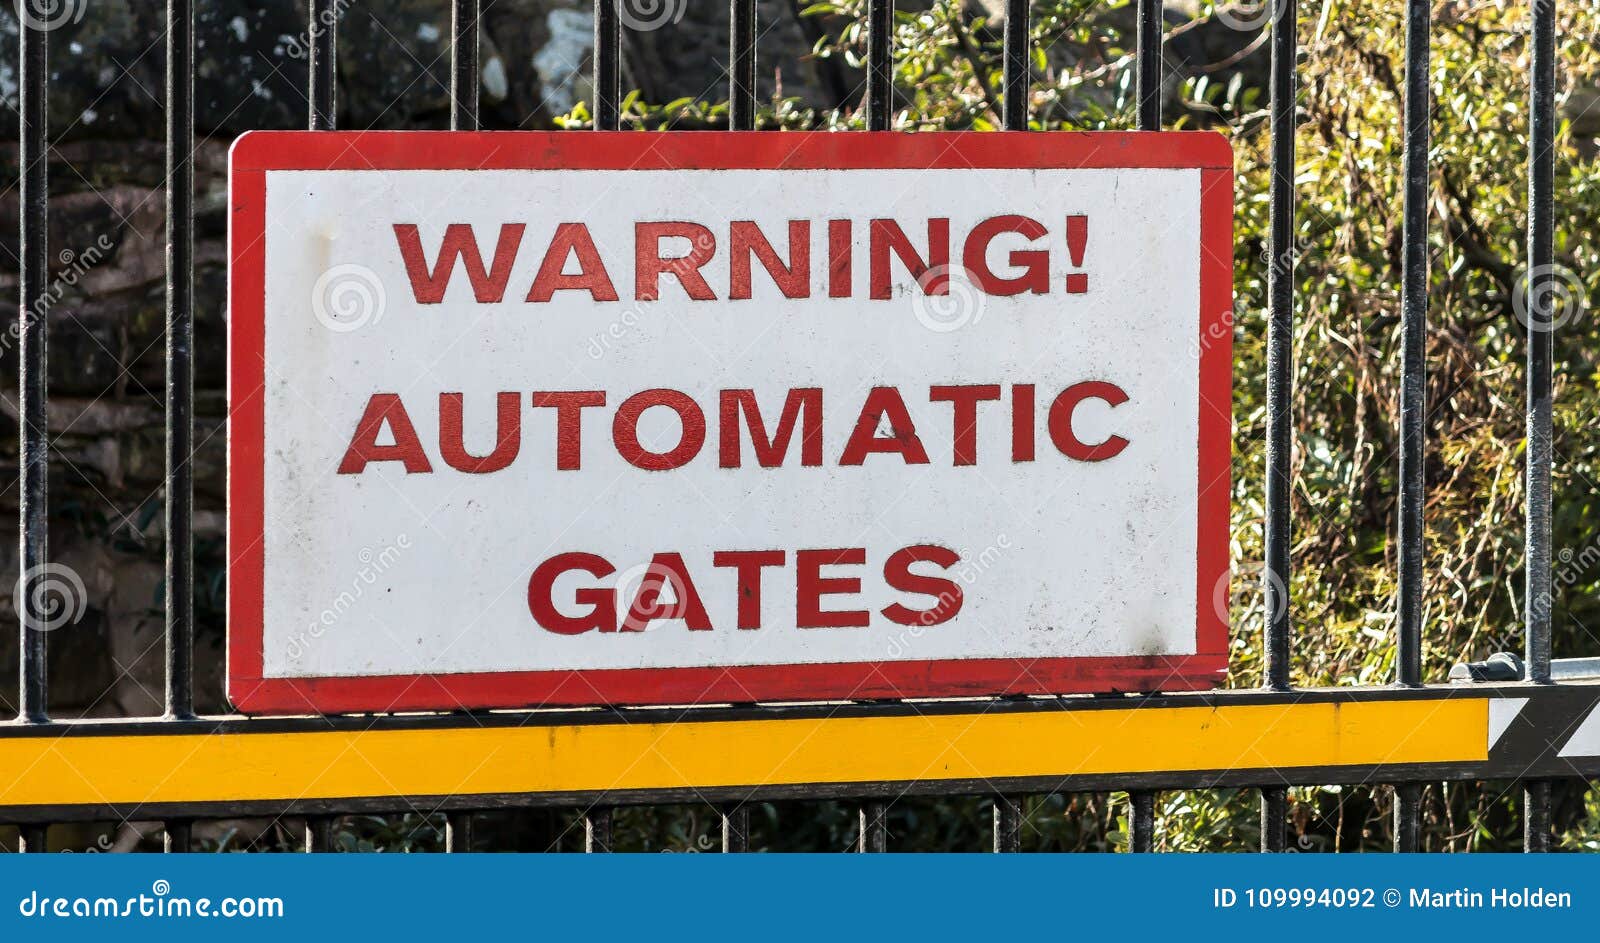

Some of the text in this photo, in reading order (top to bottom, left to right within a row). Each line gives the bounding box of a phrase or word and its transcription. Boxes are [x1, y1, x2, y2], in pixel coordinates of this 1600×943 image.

[393, 215, 1088, 304] WARNING!
[337, 381, 1130, 474] AUTOMATIC
[527, 544, 964, 635] GATES
